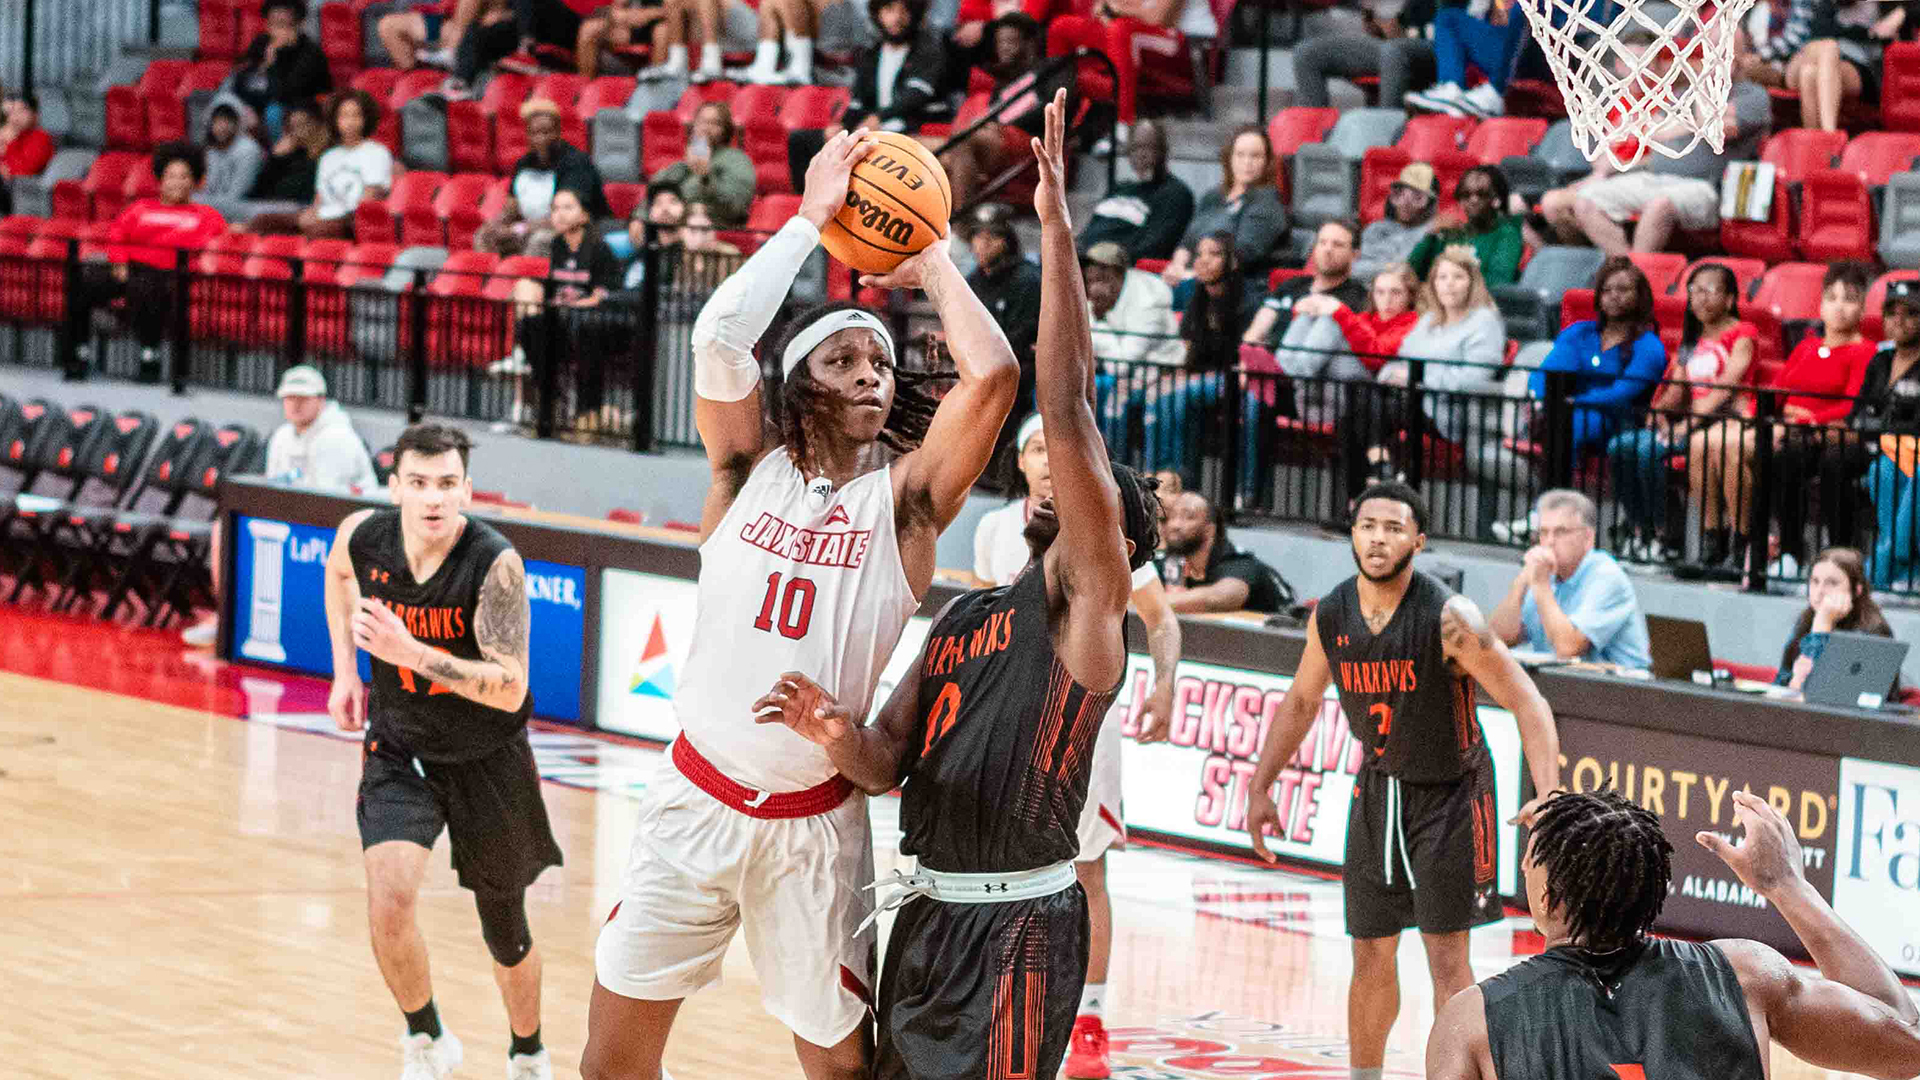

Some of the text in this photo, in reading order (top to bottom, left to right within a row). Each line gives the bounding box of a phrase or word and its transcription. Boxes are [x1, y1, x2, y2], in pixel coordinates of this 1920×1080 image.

[845, 190, 914, 247] Wilso
[291, 536, 581, 610] LaPL KNER,
[371, 595, 466, 640] HAWKS
[753, 571, 817, 641] 10
[1340, 659, 1417, 693] WARHAWKS
[1195, 755, 1323, 846] STTE
